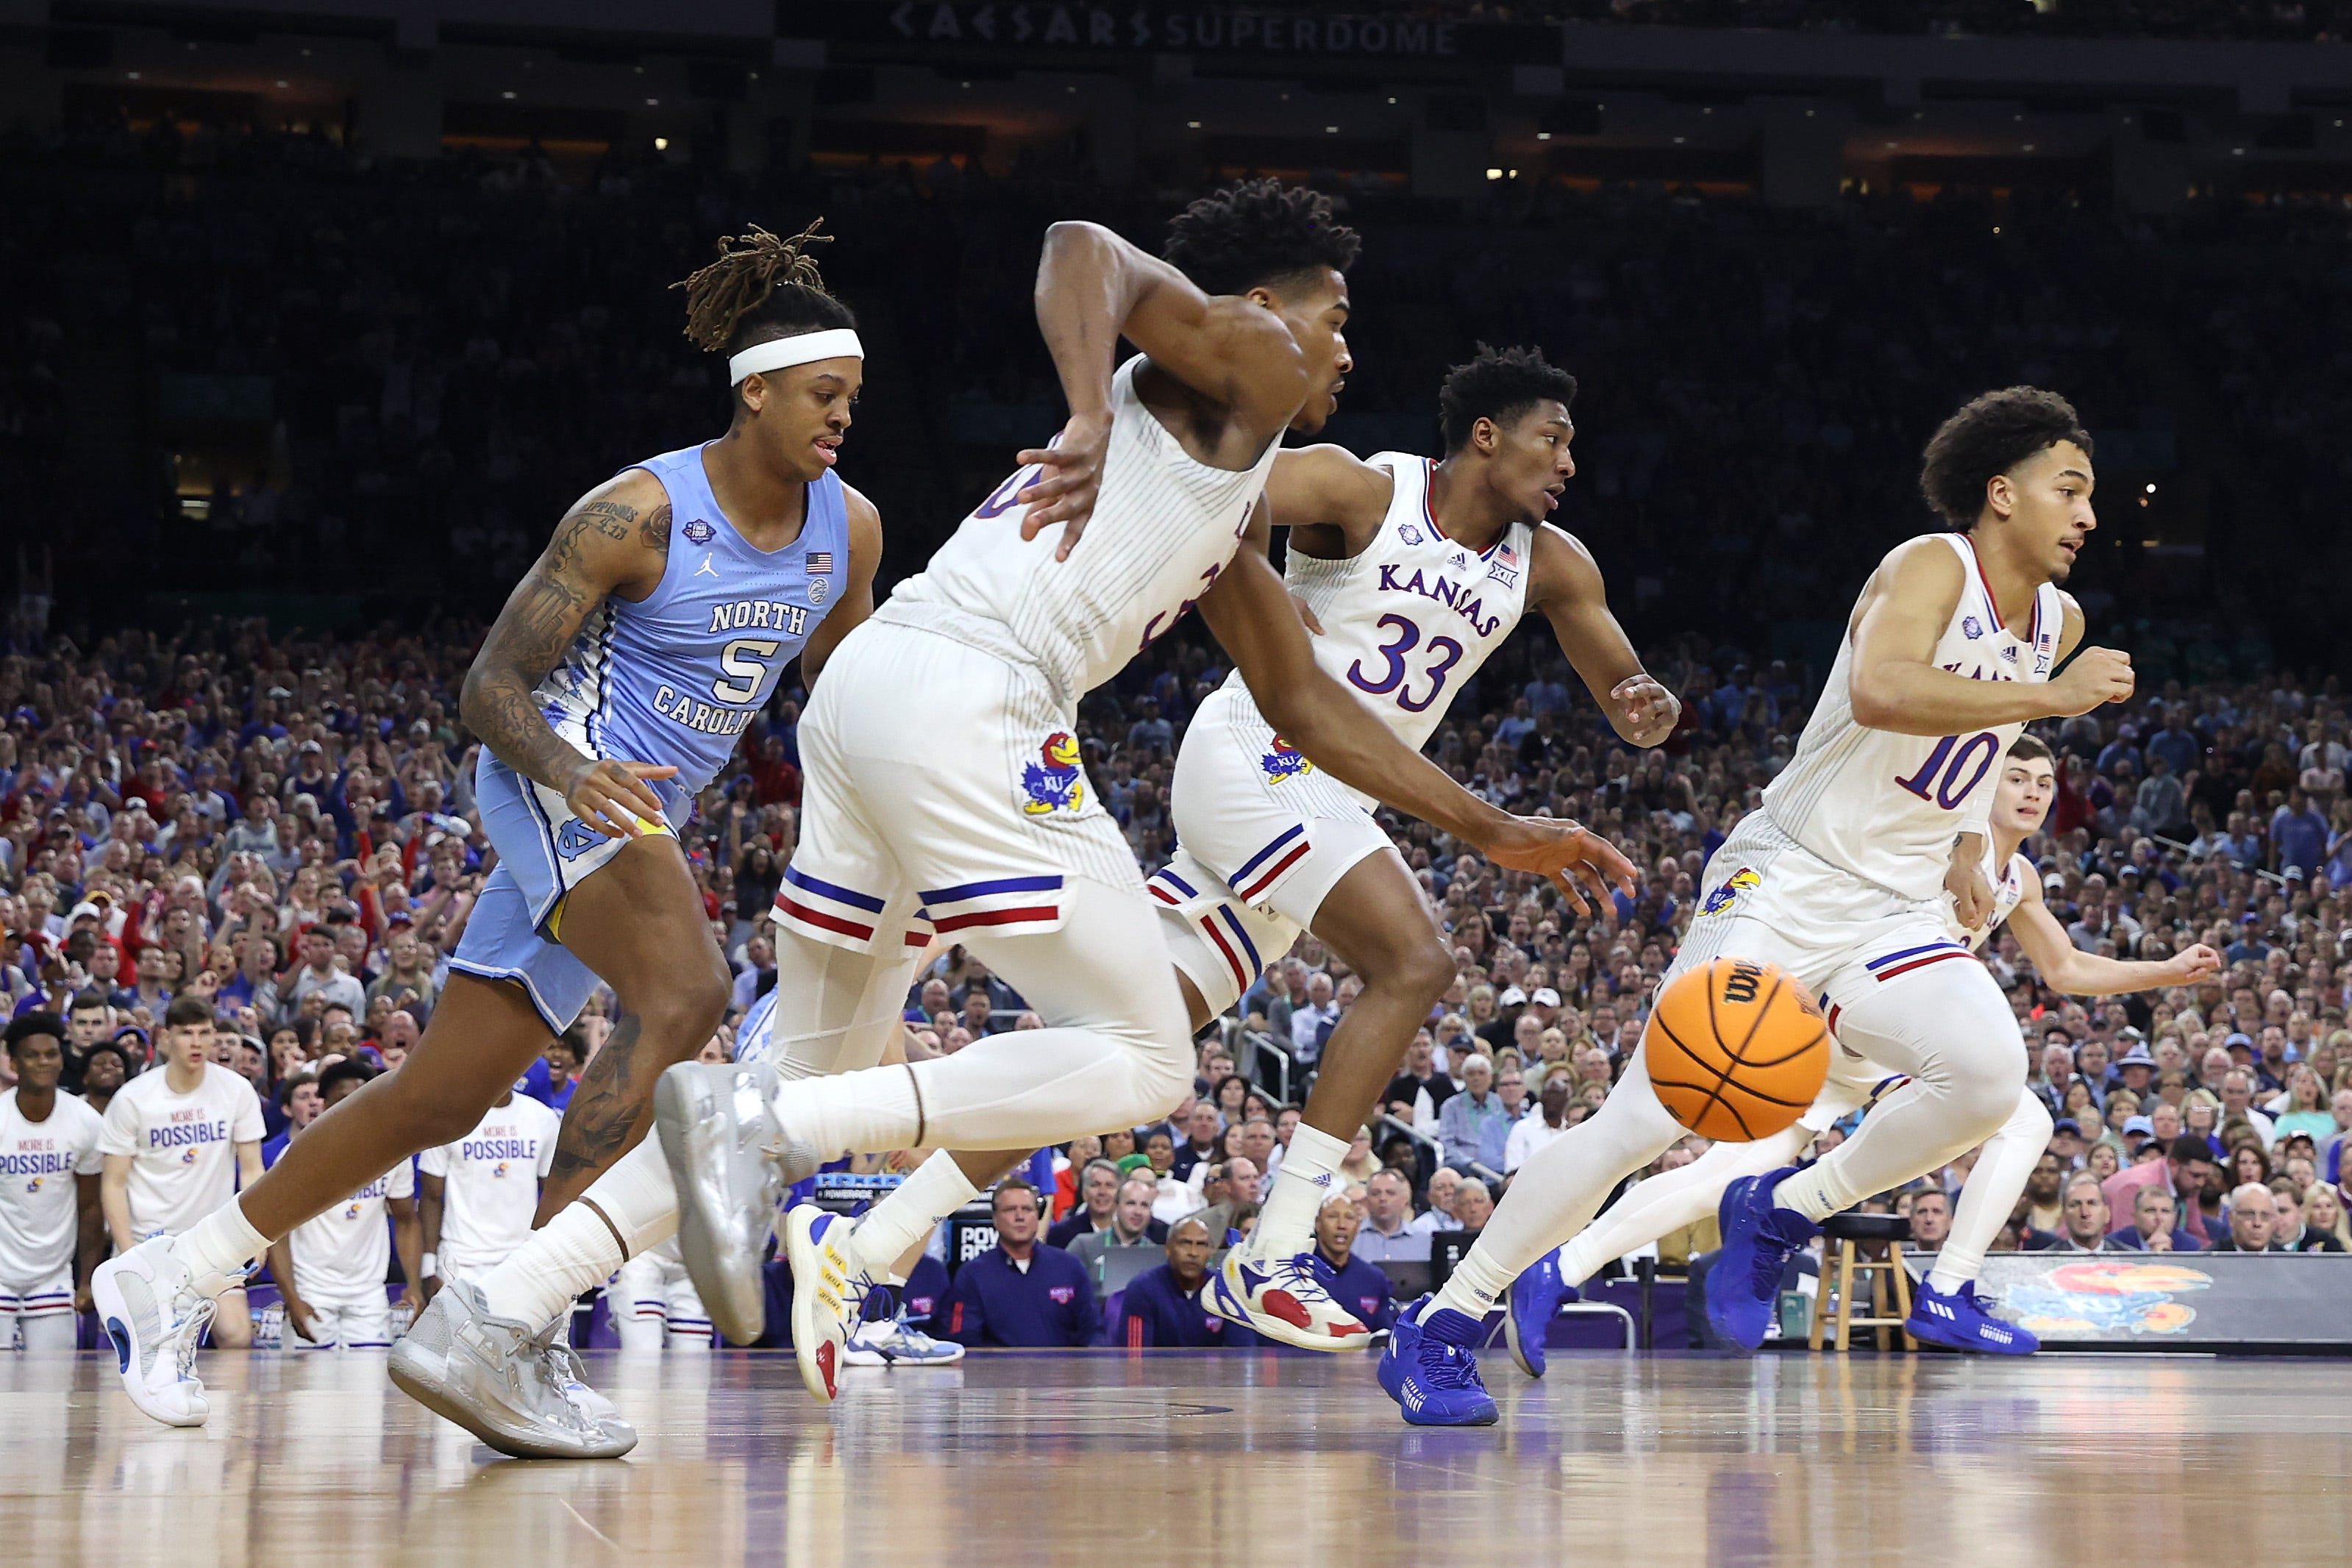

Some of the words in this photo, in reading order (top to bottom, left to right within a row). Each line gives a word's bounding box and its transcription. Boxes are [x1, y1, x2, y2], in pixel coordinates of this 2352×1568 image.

[890, 1, 1152, 46] CAESARS
[1165, 13, 1458, 54] SUPERDOME
[1447, 559, 1467, 571] adidas
[1378, 564, 1500, 638] KANSAS
[708, 600, 808, 635] NORTH
[711, 638, 781, 705] 5
[1347, 613, 1463, 713] 33
[1277, 755, 1295, 767] KU
[1895, 732, 2000, 810] 10
[1042, 775, 1063, 794] KU
[150, 1120, 227, 1148] POSSIBLE
[463, 1139, 536, 1161] POSSIBLE
[1474, 1289, 1493, 1302] adidas
